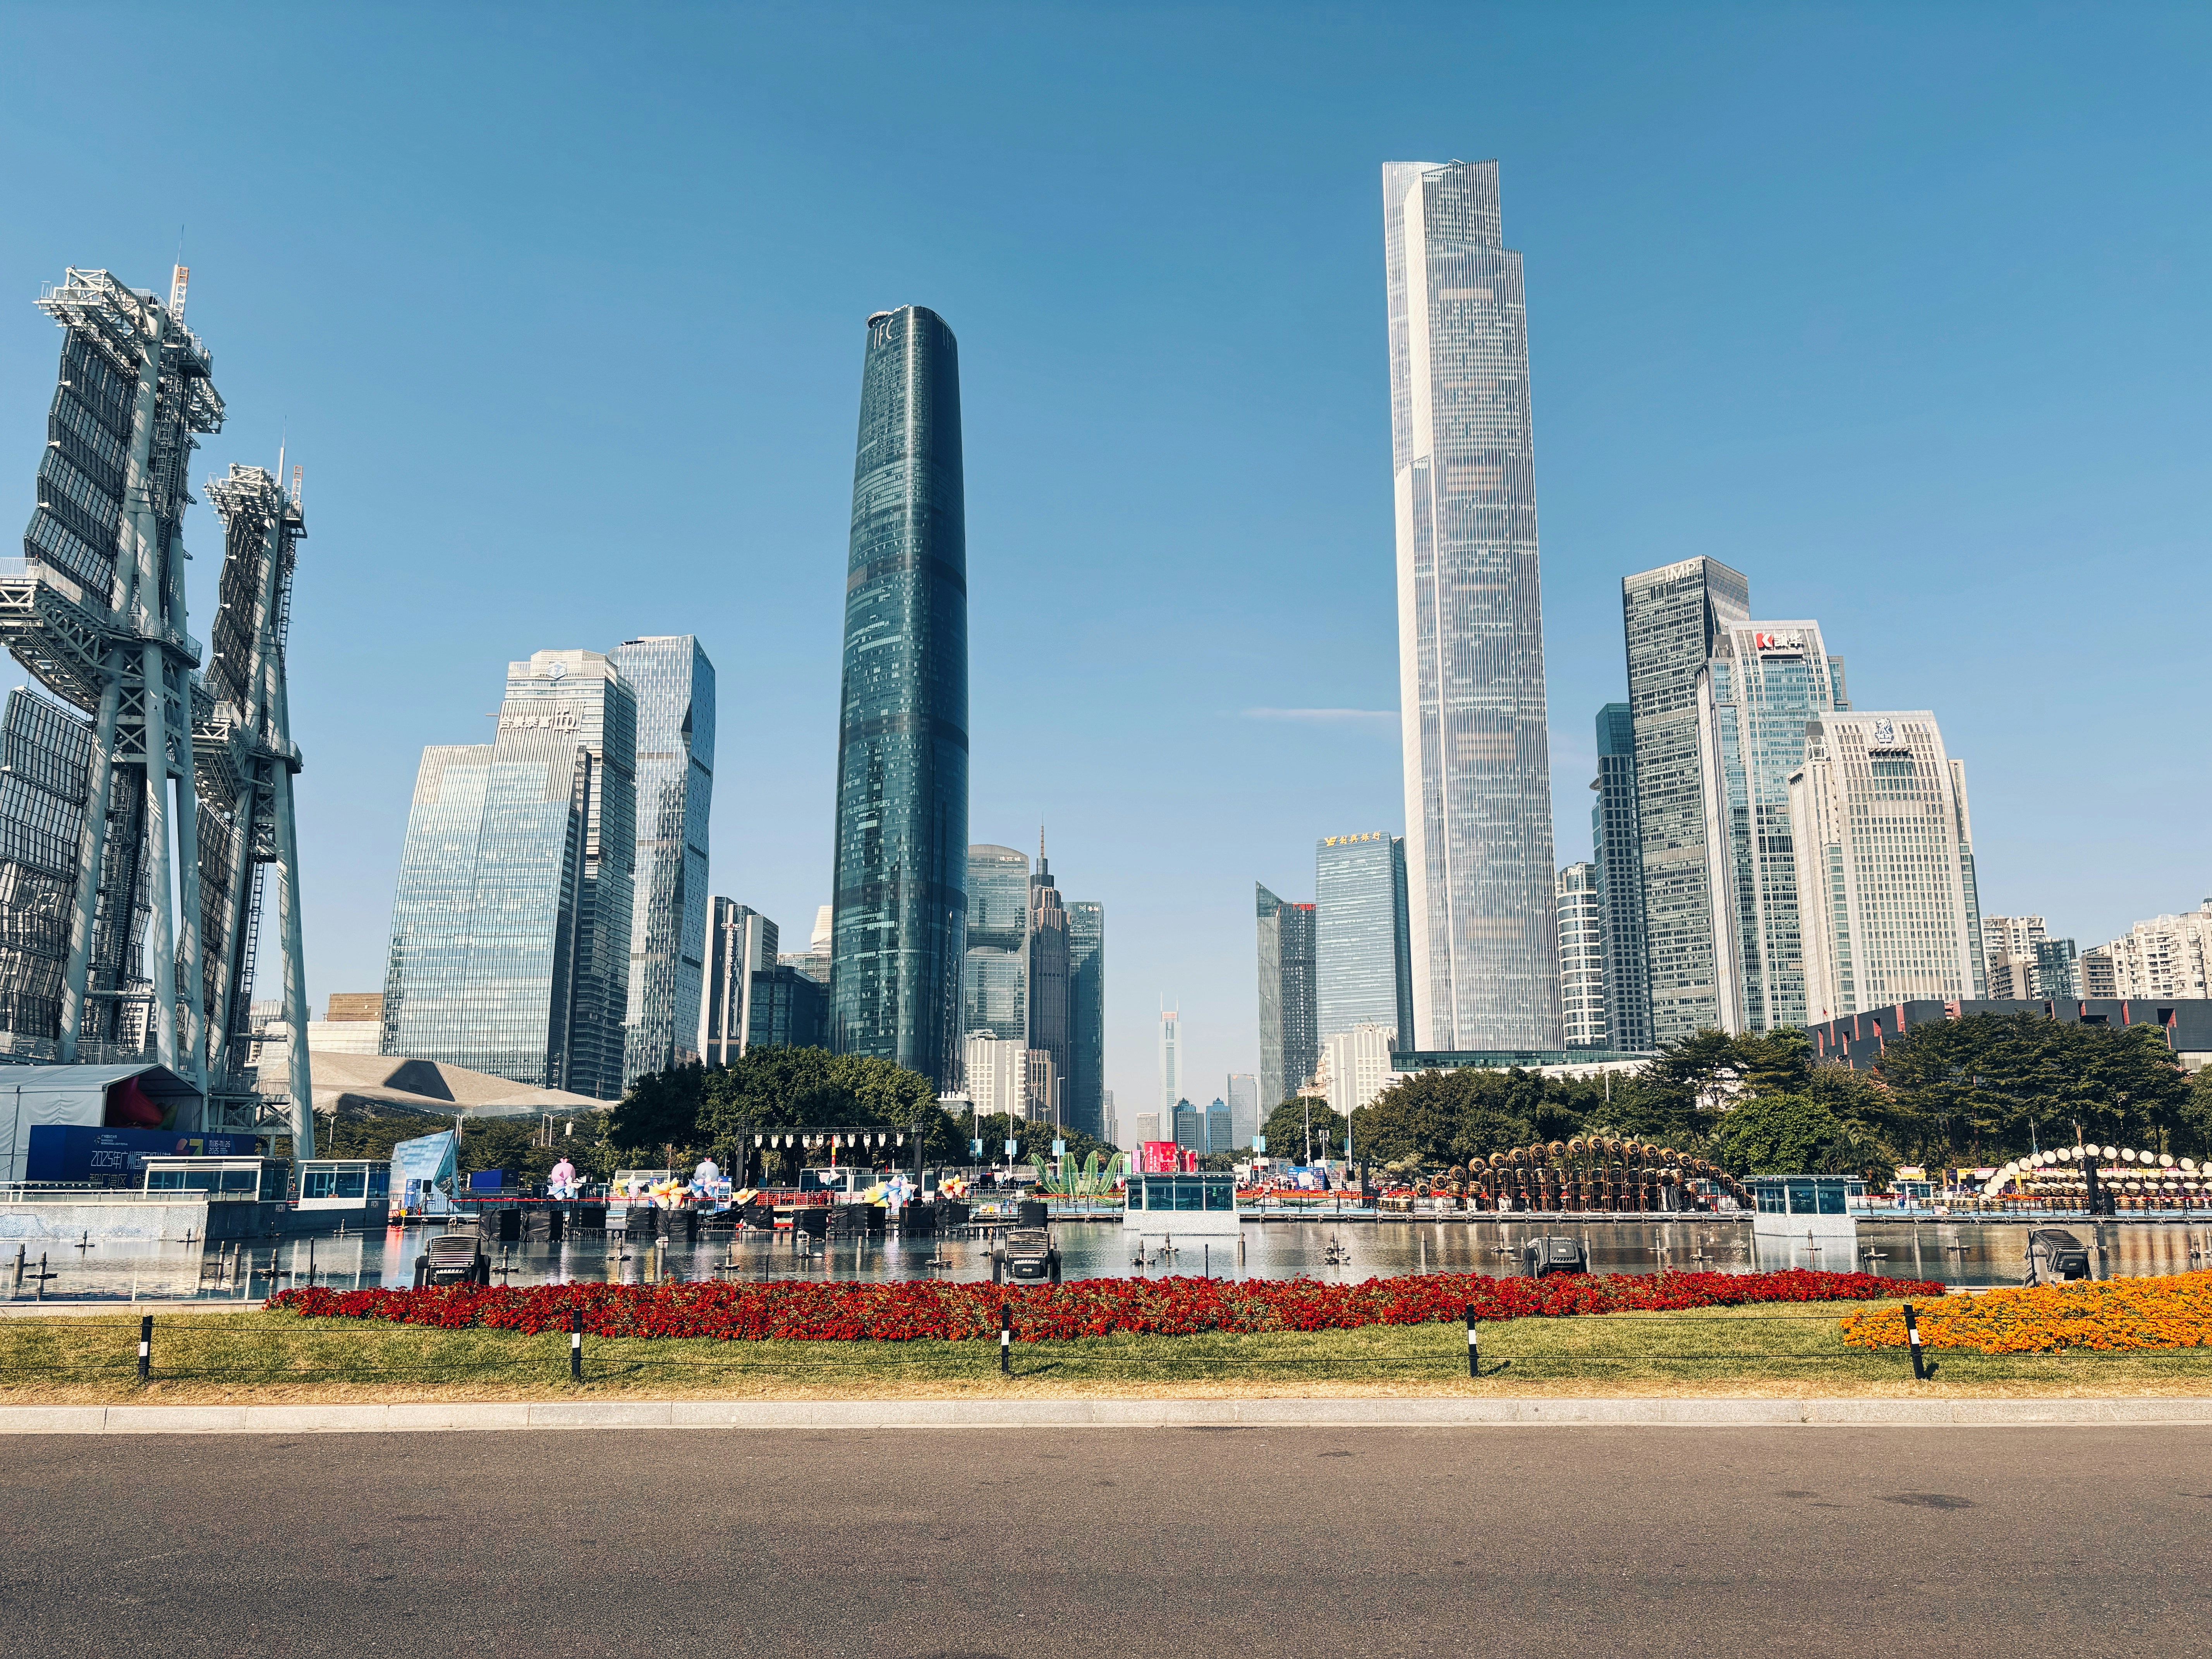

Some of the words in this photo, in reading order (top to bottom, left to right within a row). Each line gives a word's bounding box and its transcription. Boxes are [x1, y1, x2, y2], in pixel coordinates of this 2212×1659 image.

[874, 319, 893, 349] IFC
[1665, 562, 1696, 582] IMP
[1774, 633, 1803, 647] 凯华
[499, 716, 552, 729] 合景泰富
